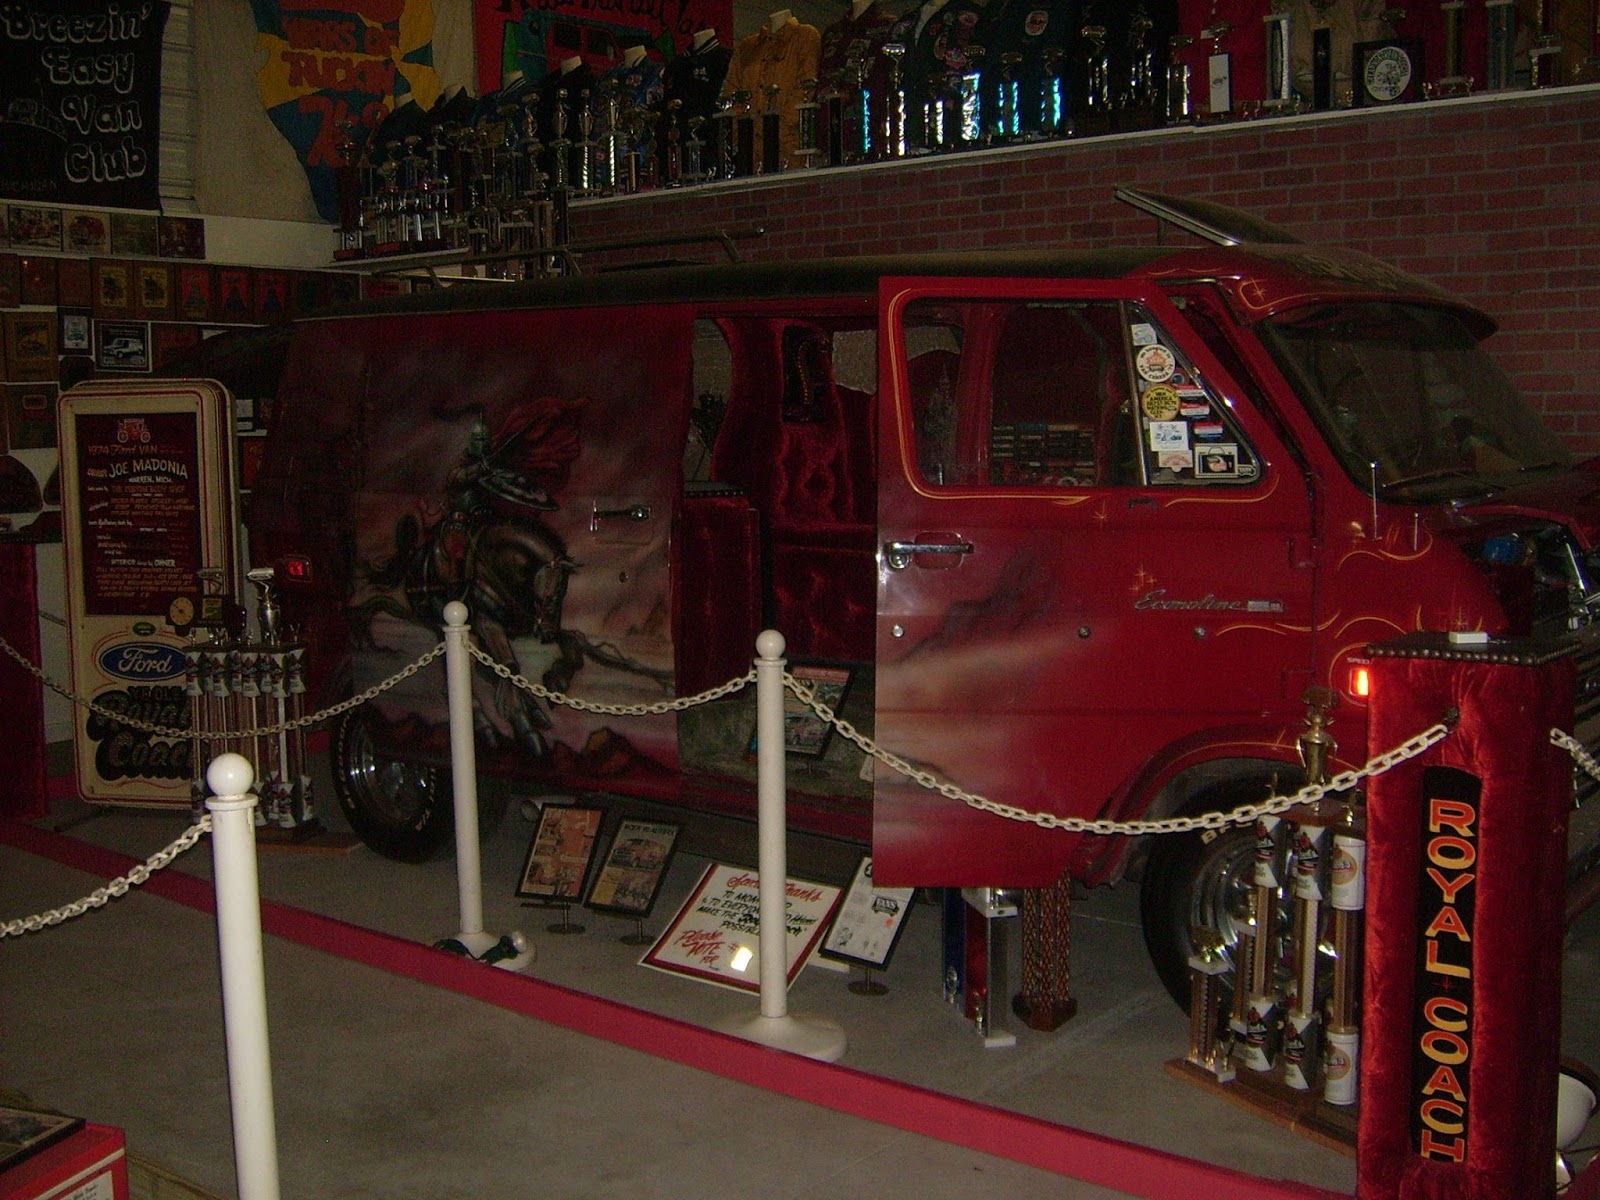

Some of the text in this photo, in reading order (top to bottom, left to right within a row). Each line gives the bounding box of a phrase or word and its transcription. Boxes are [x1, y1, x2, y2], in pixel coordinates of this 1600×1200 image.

[41, 46, 135, 94] Easy
[61, 94, 142, 135] Van
[64, 136, 147, 183] Club
[109, 462, 129, 478] JOE
[132, 458, 189, 480] MADONIA
[117, 647, 173, 674] Ford
[1424, 798, 1477, 979] ROYAL
[1419, 996, 1470, 1164] COACH
